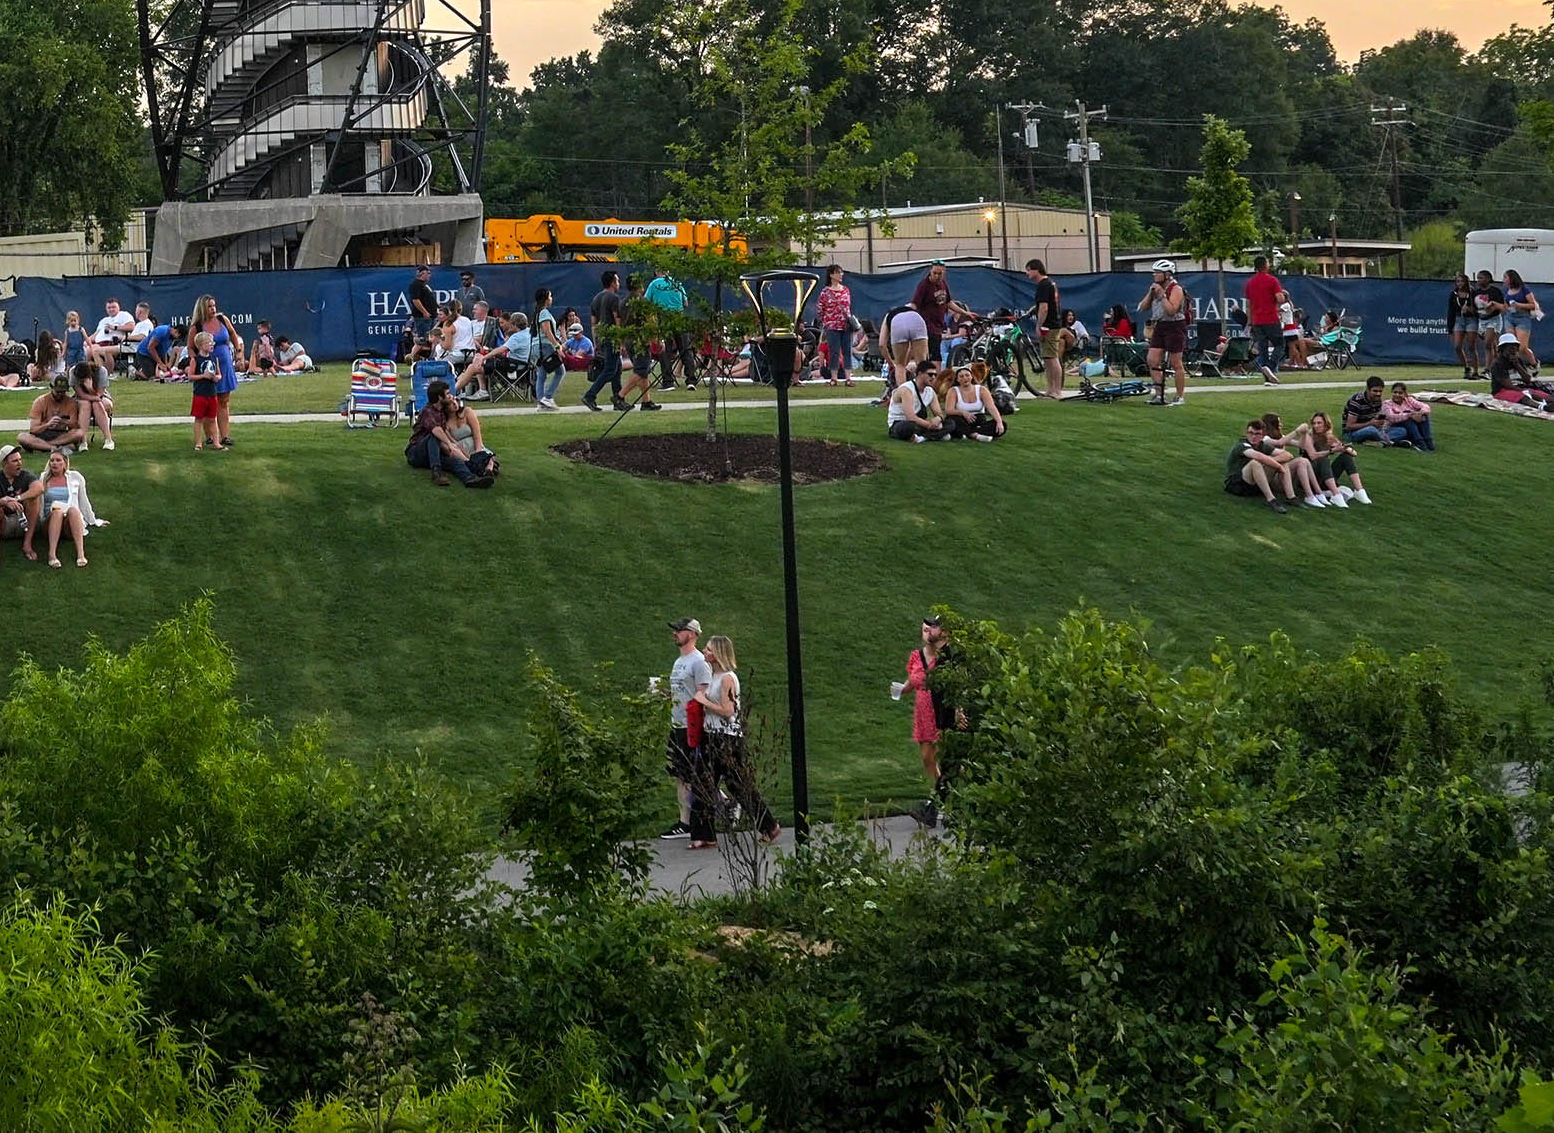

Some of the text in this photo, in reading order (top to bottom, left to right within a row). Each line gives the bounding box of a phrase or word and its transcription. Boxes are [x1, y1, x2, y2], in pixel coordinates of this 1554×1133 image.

[602, 226, 634, 236] United
[1388, 316, 1406, 325] More
[1408, 316, 1424, 325] than
[1409, 325, 1428, 334] build
